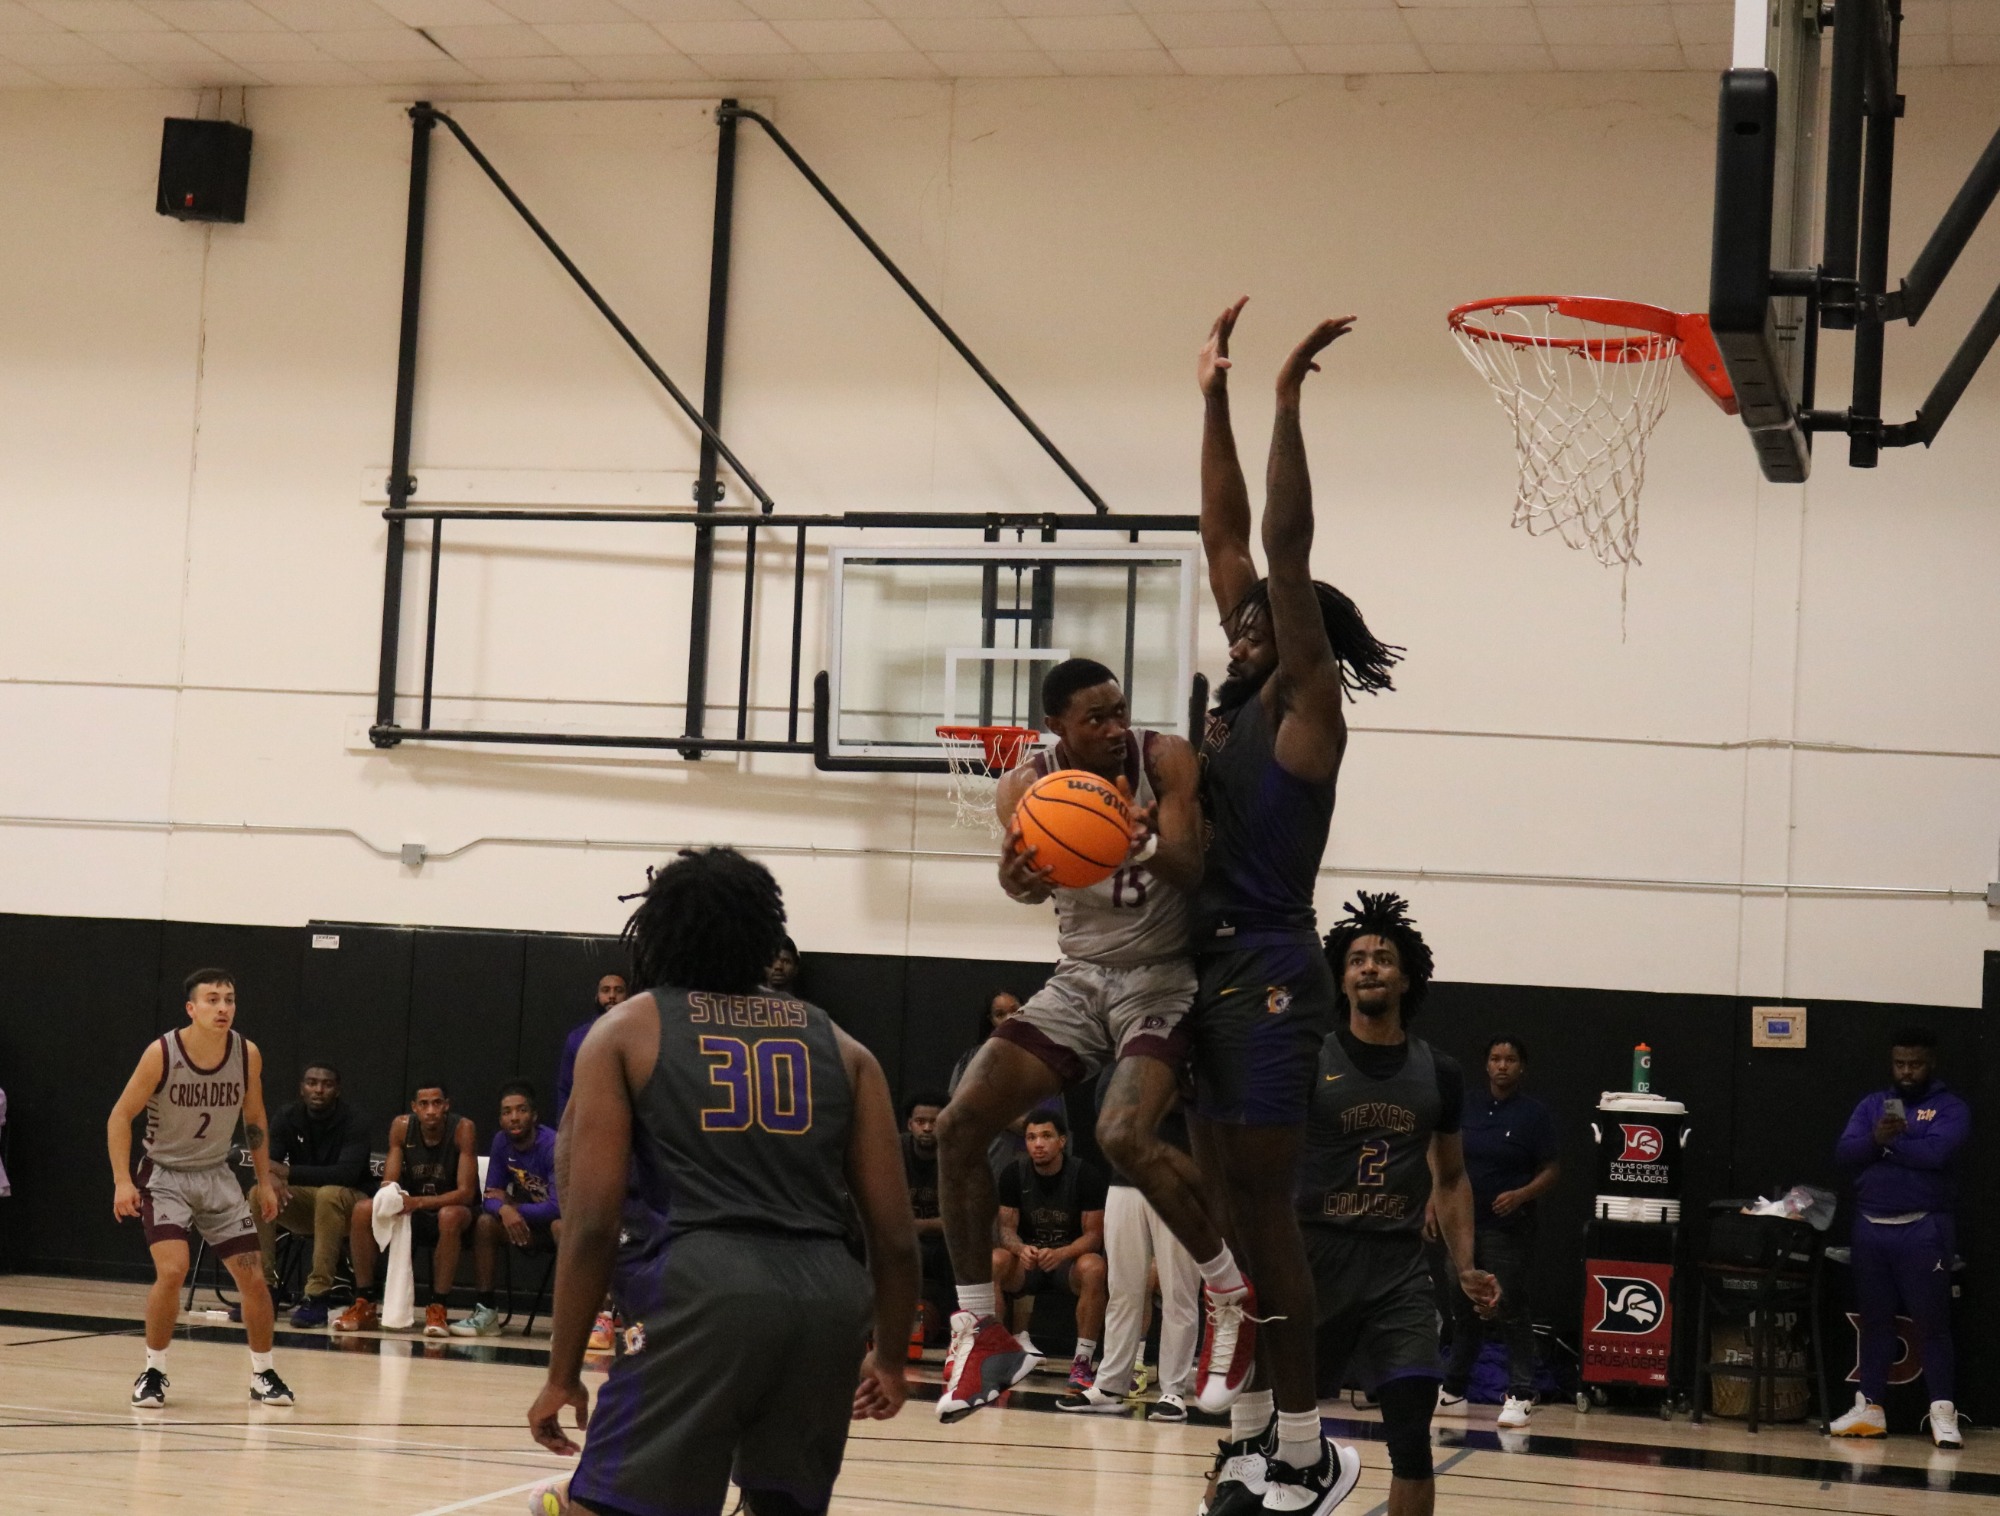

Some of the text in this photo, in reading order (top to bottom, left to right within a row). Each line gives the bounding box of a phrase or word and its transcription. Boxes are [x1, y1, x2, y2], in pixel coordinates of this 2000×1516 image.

[1112, 865, 1147, 907] 15
[688, 991, 808, 1029] STEERS
[169, 1082, 241, 1107] CRUSADERS
[699, 1035, 813, 1135] 30
[193, 1112, 211, 1139] 2
[1341, 1102, 1416, 1136] TEXAS
[1357, 1139, 1390, 1186] 2
[1610, 1162, 1635, 1170] DALLAS
[1610, 1167, 1668, 1176] COLLEGE
[1609, 1173, 1669, 1184] CRUSADERS
[1323, 1192, 1409, 1220] COLLEGE
[1586, 1353, 1666, 1371] CRUSADERS
[1588, 1344, 1665, 1356] COLLEGE
